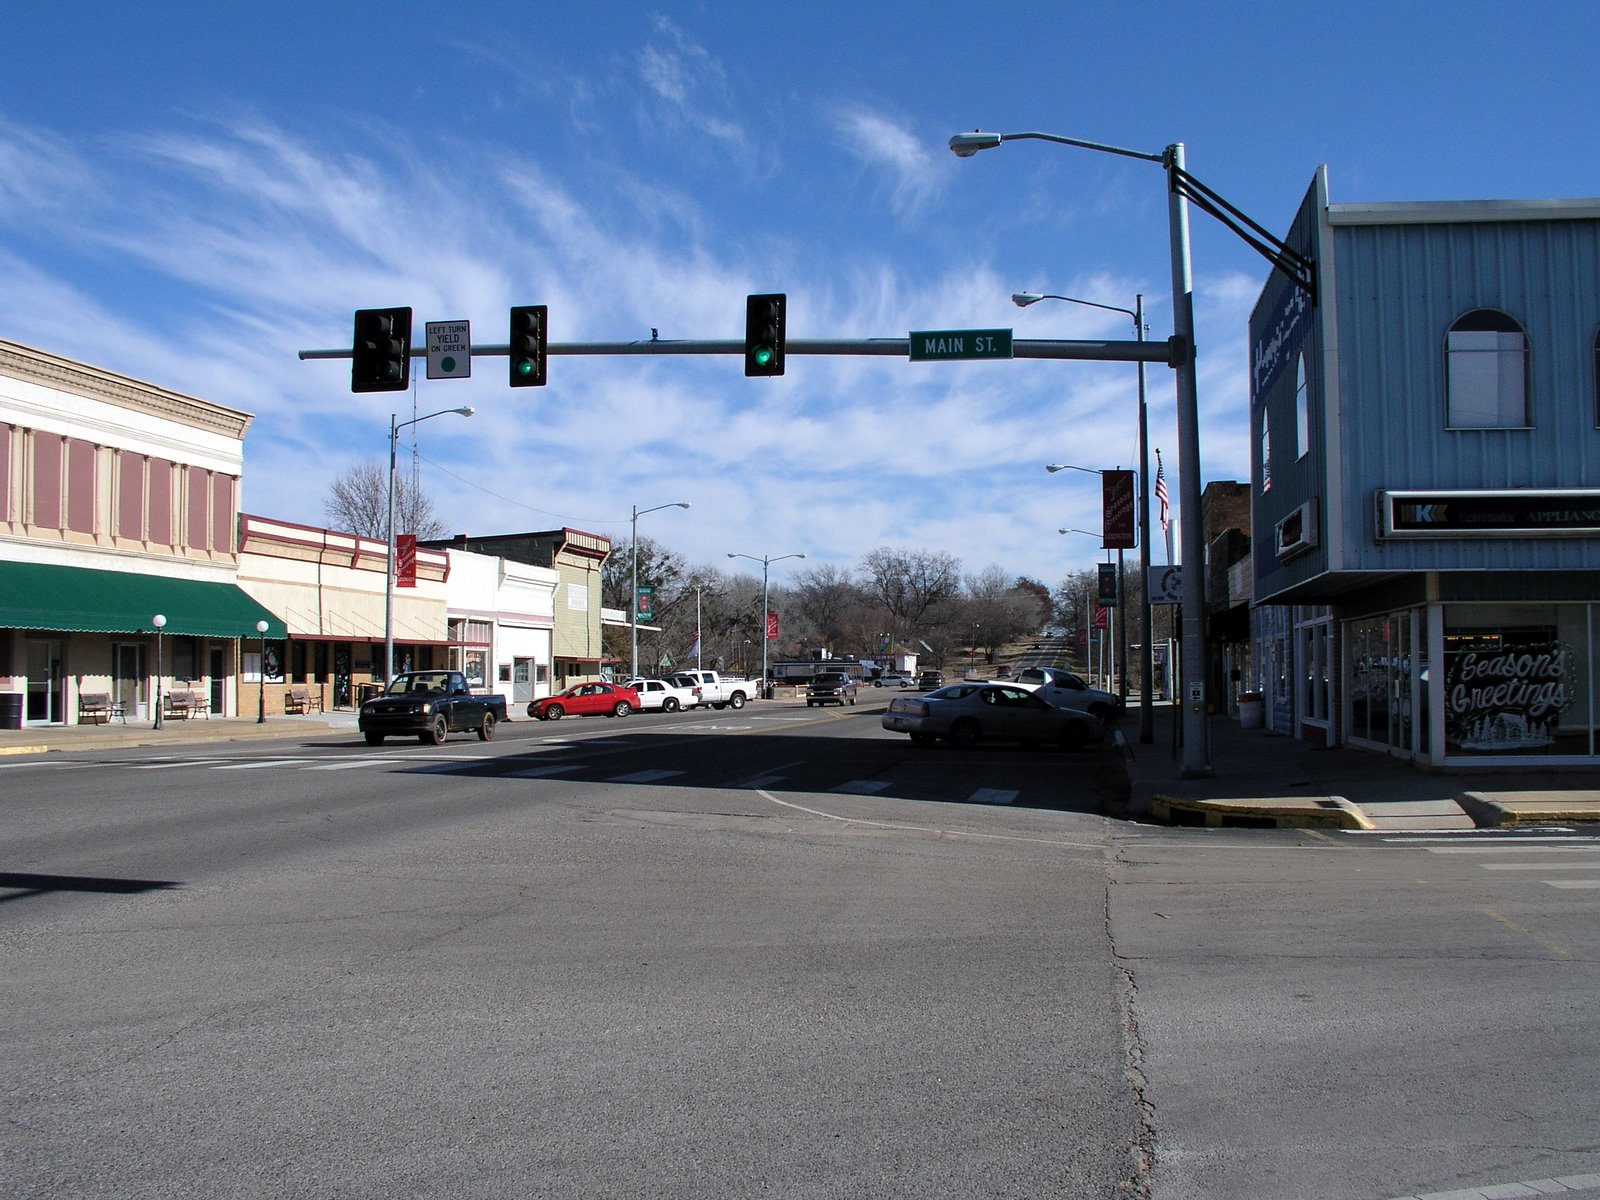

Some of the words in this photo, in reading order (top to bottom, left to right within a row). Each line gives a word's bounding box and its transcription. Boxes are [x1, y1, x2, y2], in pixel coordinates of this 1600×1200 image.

[448, 325, 466, 333] TURN
[437, 334, 459, 343] YIELD
[443, 344, 466, 352] GREEN
[925, 338, 963, 353] MAIN
[975, 336, 996, 352] ST.
[1452, 678, 1568, 717] Greetings
